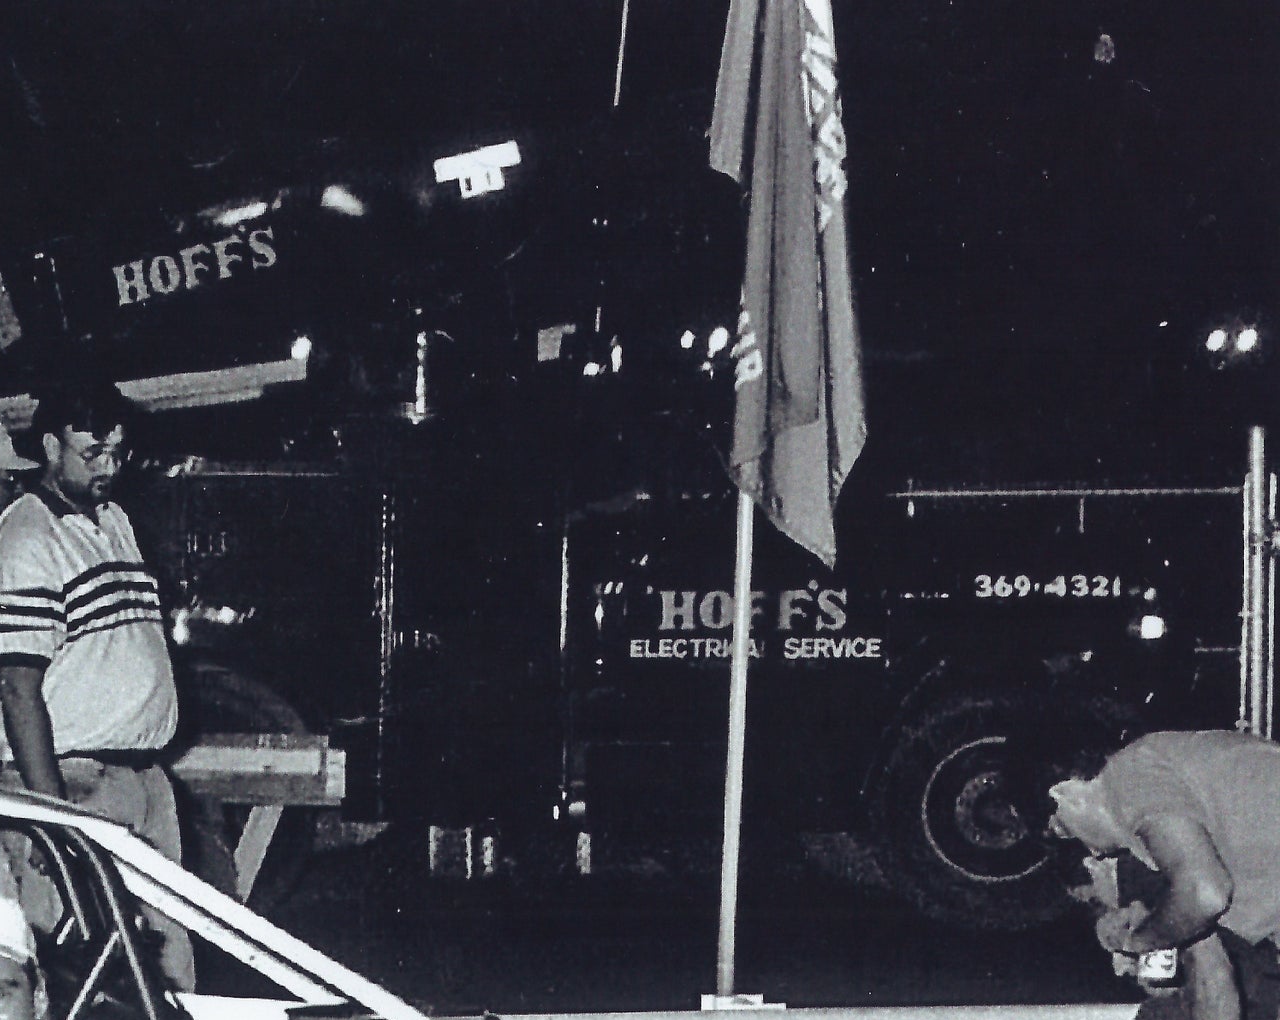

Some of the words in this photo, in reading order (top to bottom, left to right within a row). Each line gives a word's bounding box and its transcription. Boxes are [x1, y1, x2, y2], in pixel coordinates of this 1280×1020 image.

[112, 225, 277, 306] HOFF'S
[629, 637, 766, 659] ELECTRIAL
[783, 637, 882, 660] SERVICE
